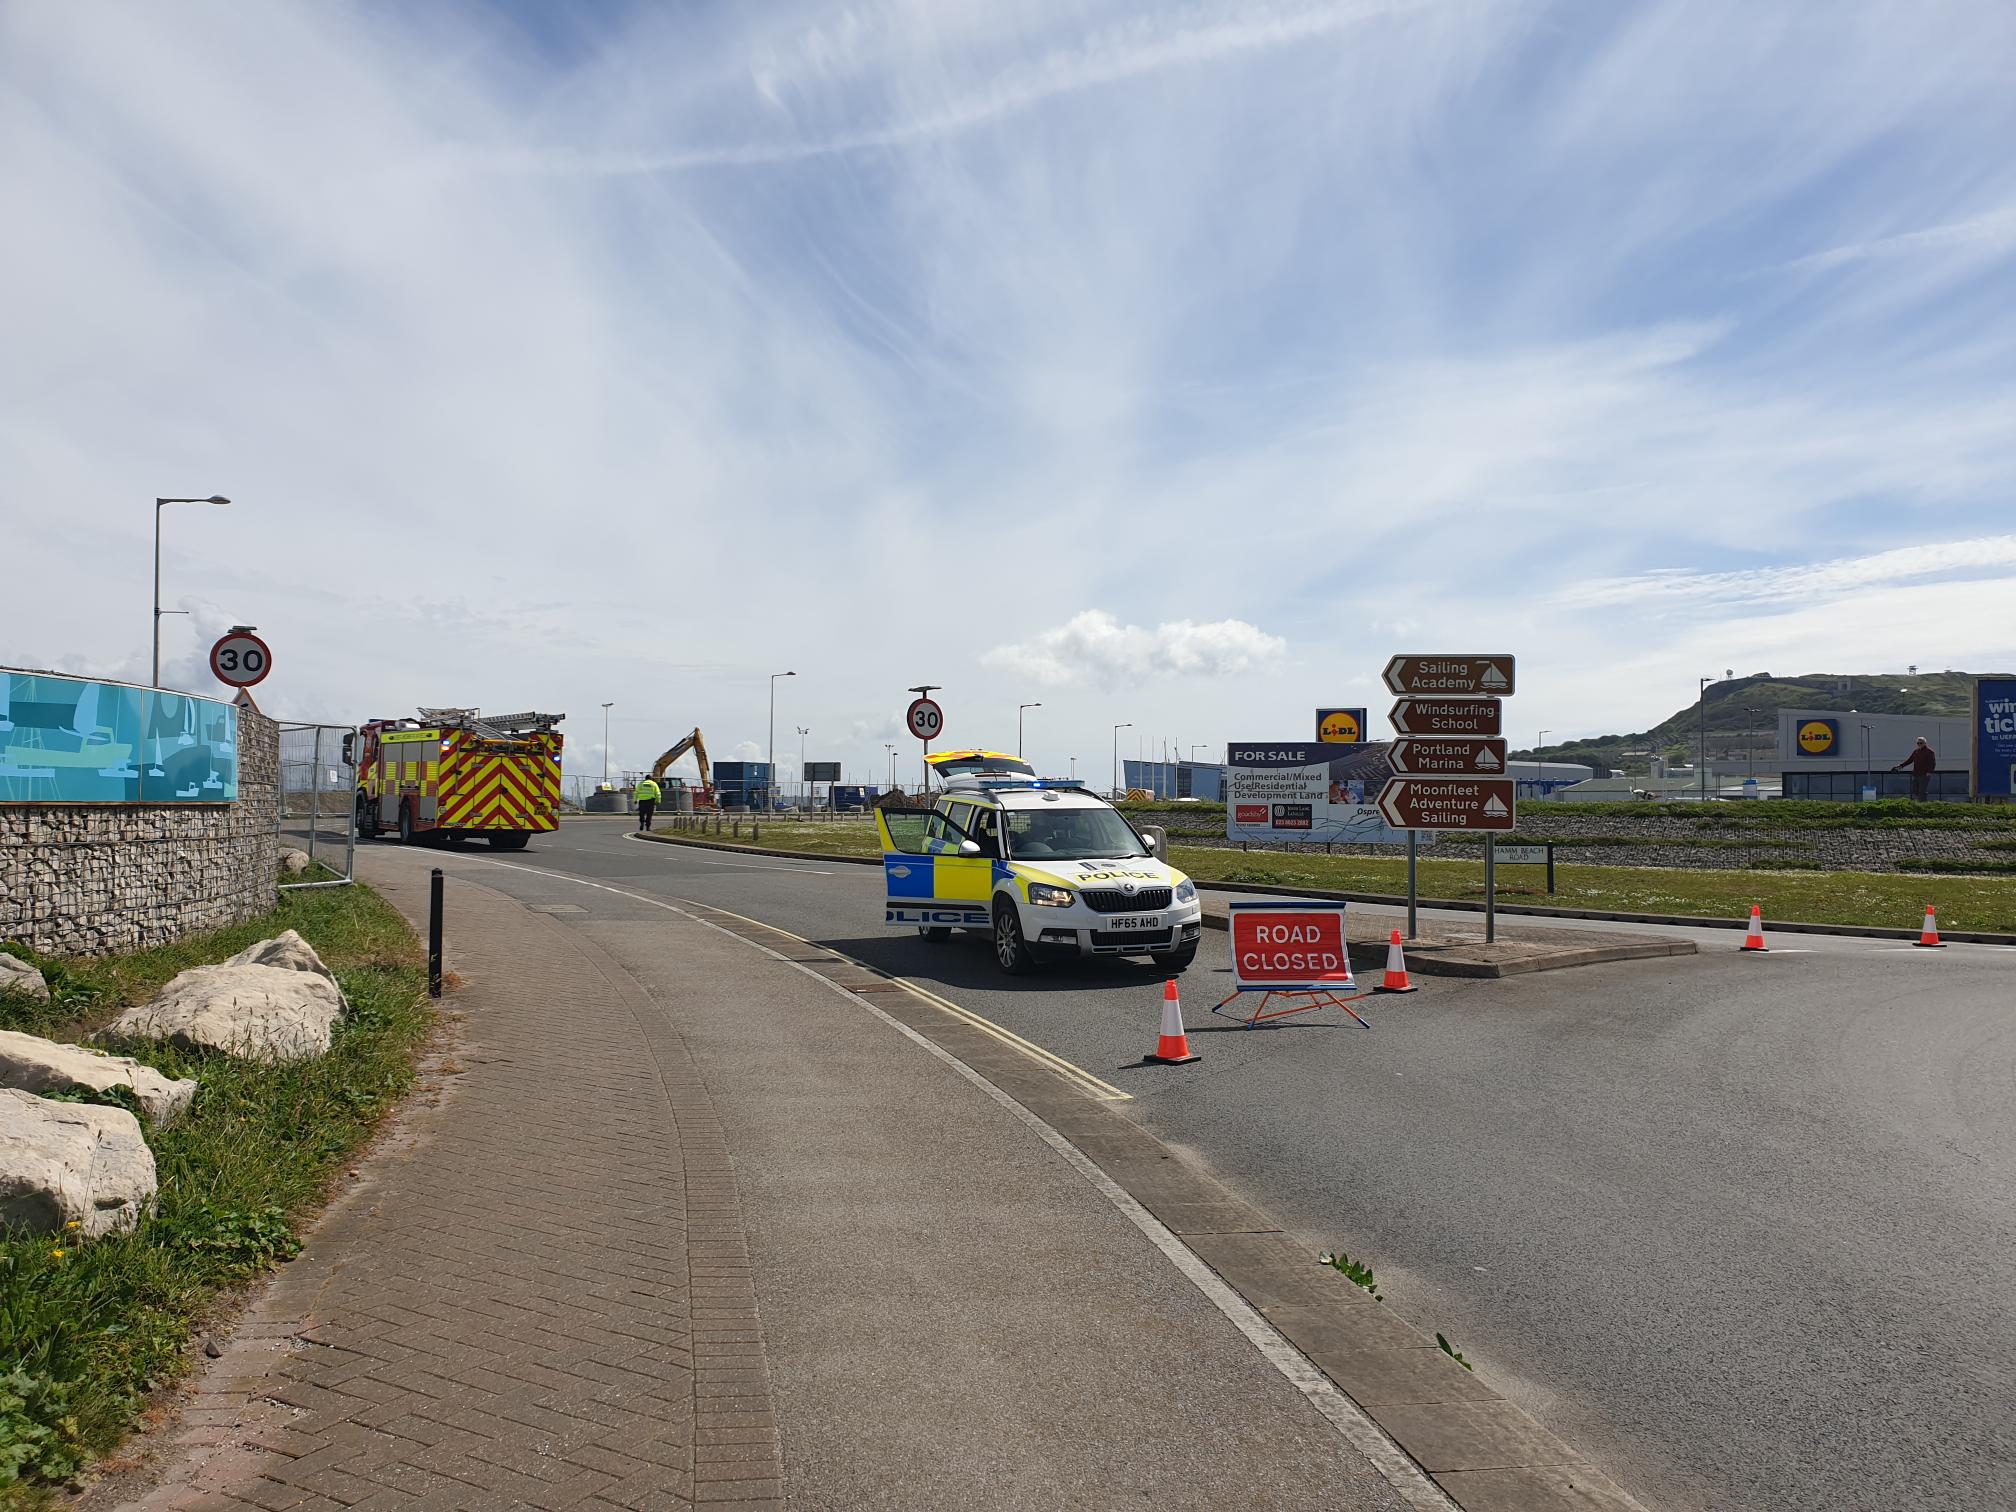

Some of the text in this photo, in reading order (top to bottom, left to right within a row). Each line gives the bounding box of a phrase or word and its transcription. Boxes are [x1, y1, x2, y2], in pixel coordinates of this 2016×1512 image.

[220, 649, 263, 671] 30
[1419, 662, 1468, 675] Sailing
[1411, 677, 1475, 690] Academy
[1415, 703, 1495, 717] Windsurfing
[915, 711, 938, 728] 30
[1432, 718, 1478, 730] School
[1984, 713, 2016, 733] tic
[1413, 744, 1470, 755] Portland
[1235, 751, 1306, 761] FOR SALE
[1418, 758, 1464, 769] Marina
[1234, 772, 1322, 781] Commercial/Mixed
[1234, 791, 1323, 800] Development Land
[1410, 784, 1479, 796] Moonfleet
[1409, 798, 1479, 809] Adventure
[1357, 808, 1380, 816] Ospre
[1421, 812, 1467, 825] Sailing
[1078, 872, 1159, 881] POLICE
[886, 911, 989, 923] LICE
[1111, 917, 1159, 929] HF65 AHD
[1256, 925, 1321, 943] ROAD
[1243, 953, 1338, 970] CLOSED
